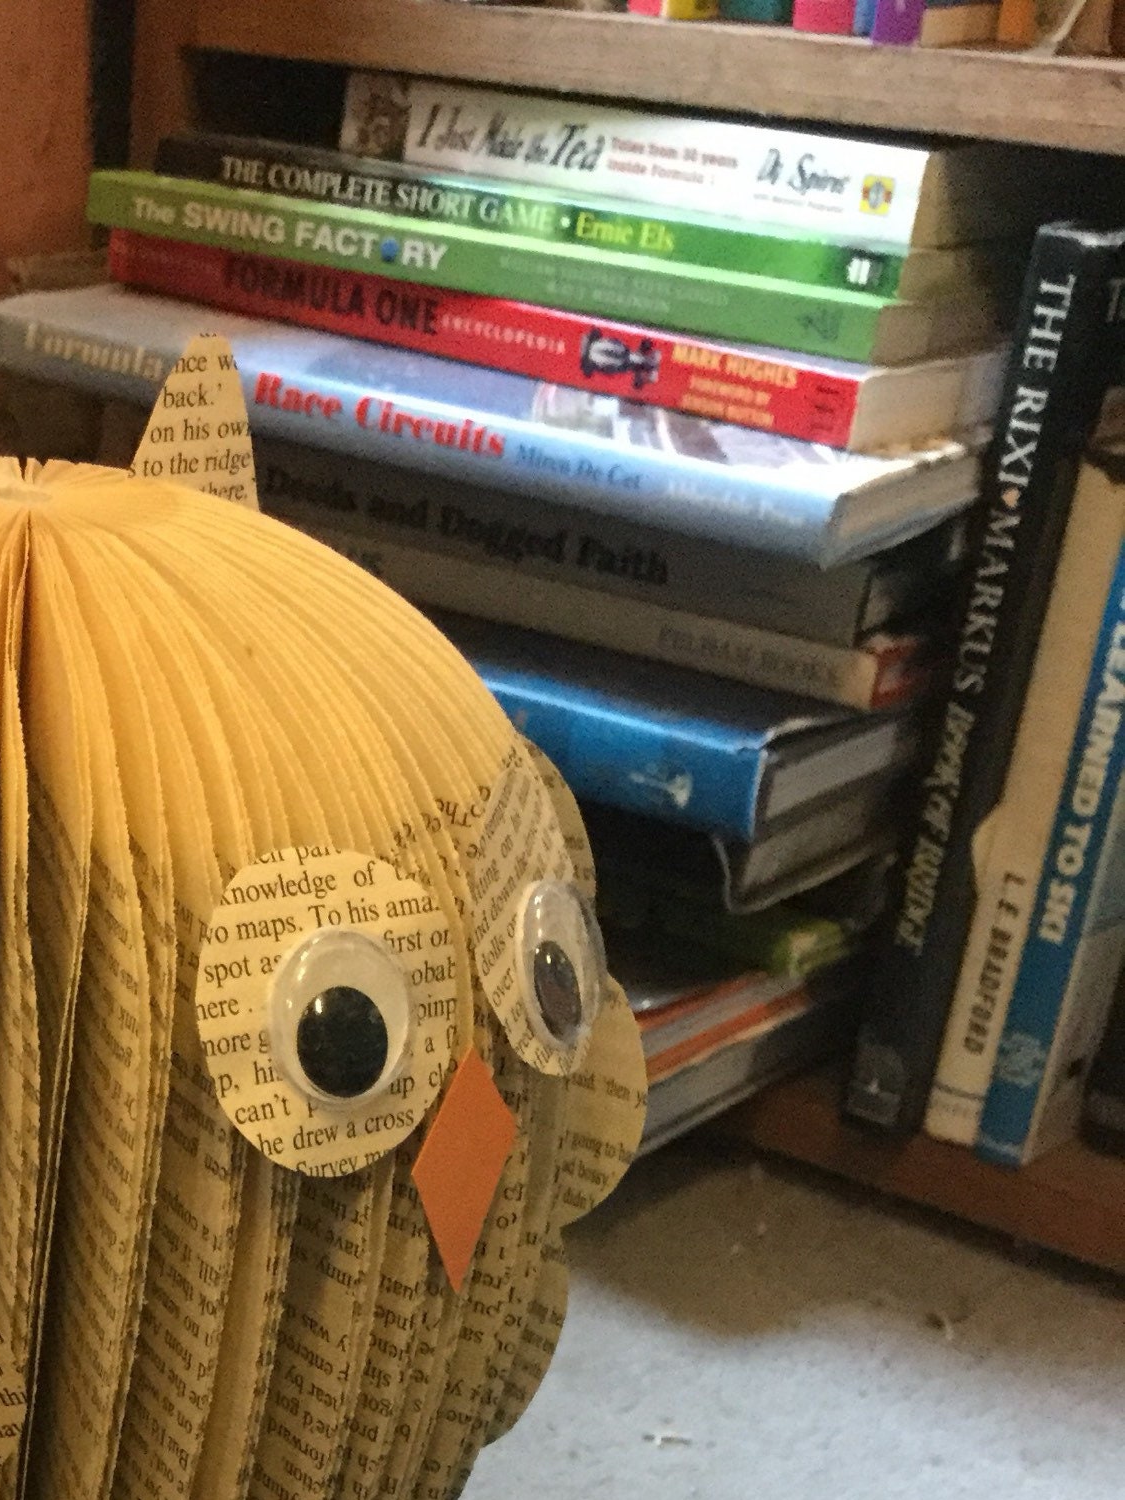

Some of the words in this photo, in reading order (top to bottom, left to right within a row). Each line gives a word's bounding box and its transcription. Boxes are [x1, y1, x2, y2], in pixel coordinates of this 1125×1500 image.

[133, 196, 176, 225] The
[183, 200, 286, 246] SWING
[221, 156, 259, 185] THE
[269, 162, 391, 206] COMPLETE
[397, 181, 473, 220] SHORT
[479, 192, 554, 233] GAME
[576, 212, 635, 249] Ernie
[641, 223, 675, 253] Els
[223, 253, 366, 317] FORMULA
[377, 287, 441, 336] ONE
[672, 345, 721, 374] MARK
[725, 350, 799, 389] HUGHES
[1023, 274, 1077, 374] THE
[24, 322, 165, 381] Formula
[254, 372, 342, 420] Race
[355, 396, 507, 459] Circuits
[149, 425, 175, 444] on
[182, 416, 210, 441] his
[998, 383, 1050, 488] RIXI
[142, 458, 164, 477] to
[168, 450, 199, 475] the
[203, 447, 252, 476] ridge
[578, 538, 670, 585] Faith
[954, 511, 1022, 692] MARKUS
[352, 858, 376, 888] of
[1055, 820, 1099, 878] TO
[234, 915, 304, 943] maps.
[306, 903, 342, 928] To
[344, 896, 380, 924] his
[1038, 888, 1081, 943] SKI
[202, 955, 252, 989] spot
[963, 927, 1015, 1059] BRADFORD
[233, 1092, 291, 1125] can't
[255, 1132, 285, 1159] he
[291, 1123, 339, 1151] drew
[345, 1119, 357, 1139] a
[363, 1108, 414, 1135] cross
